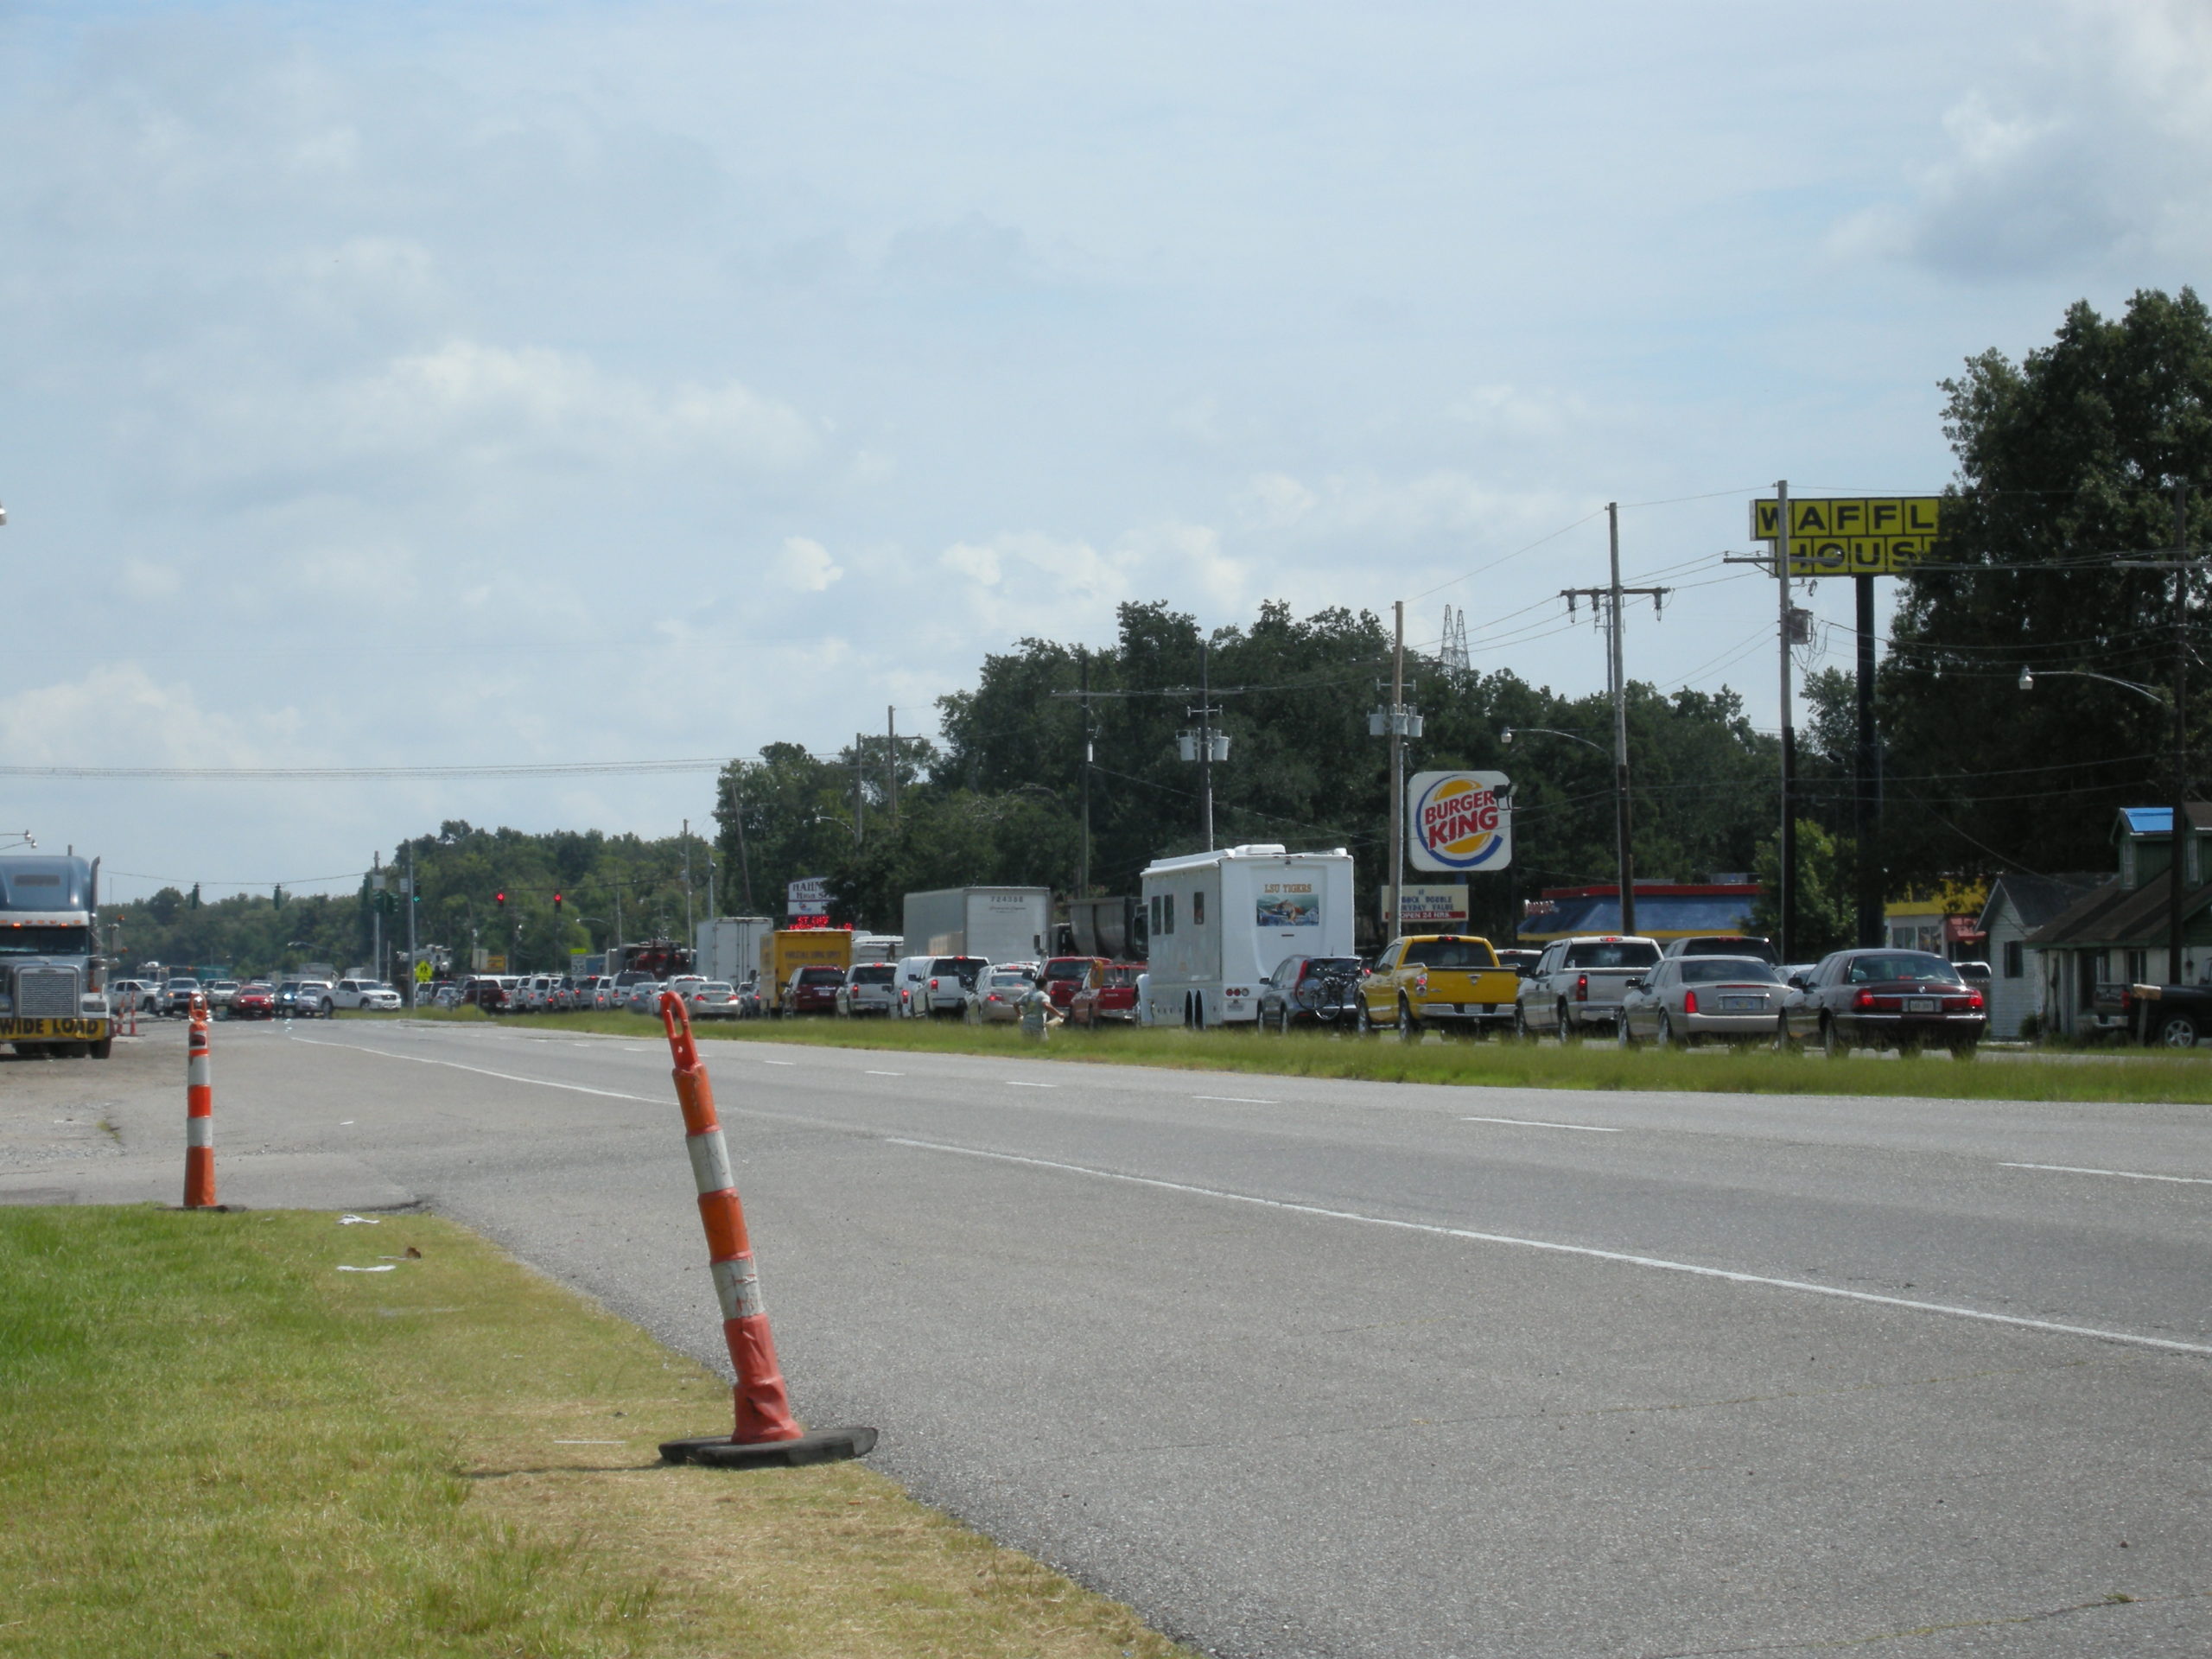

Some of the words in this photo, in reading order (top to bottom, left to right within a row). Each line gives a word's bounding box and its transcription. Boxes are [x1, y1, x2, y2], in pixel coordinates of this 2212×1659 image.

[1760, 505, 1934, 531] WAFFL
[1789, 542, 1938, 568] HOUS
[1425, 790, 1495, 825] BURGER
[1427, 805, 1499, 850] KING
[1264, 883, 1281, 893] LSU
[1282, 883, 1313, 893] TIGERS
[1401, 903, 1427, 912] RYDAY
[0, 1018, 45, 1035] WIDE
[53, 1018, 99, 1035] LOAD
